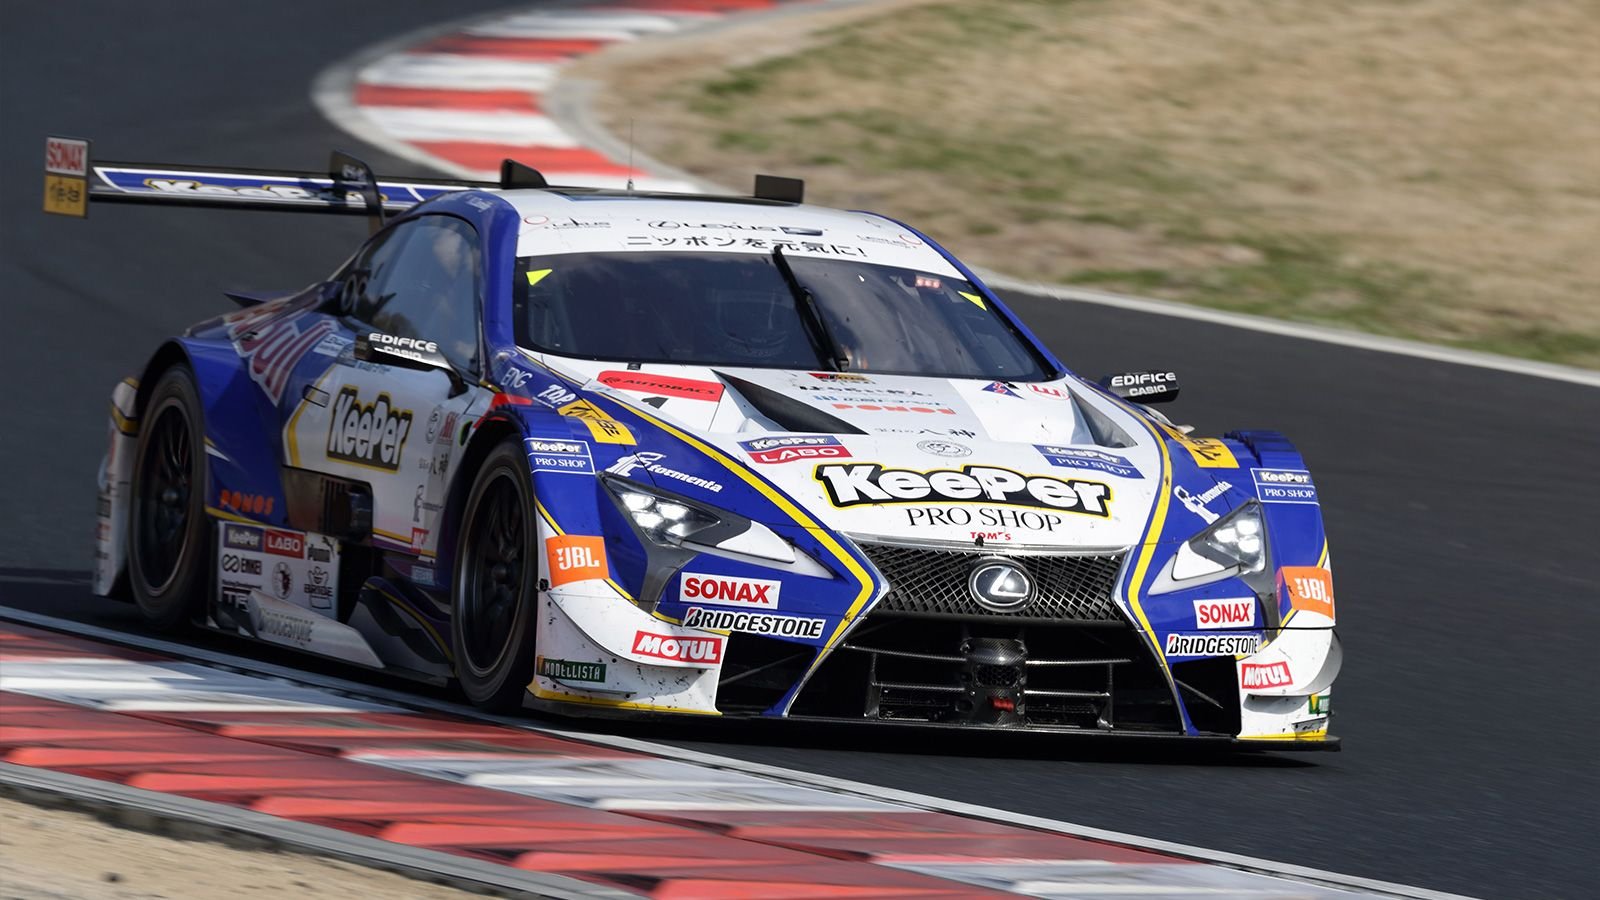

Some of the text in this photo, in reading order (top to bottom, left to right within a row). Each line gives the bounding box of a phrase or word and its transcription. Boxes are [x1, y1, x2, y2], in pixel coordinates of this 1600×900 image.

[368, 332, 438, 353] EDIFICE
[622, 377, 715, 395] AUTOBACS
[1111, 372, 1177, 387] EDIFICE
[1129, 385, 1167, 397] CASIO
[328, 386, 412, 473] KeePer
[530, 440, 582, 453] KeePer
[749, 436, 828, 451] KeePer
[535, 457, 586, 468] PRO SHOP
[760, 448, 840, 462] LABO
[1045, 446, 1122, 464] KeePer
[1057, 457, 1131, 475] PRO SHOP
[1259, 471, 1311, 484] KeePer
[816, 463, 1111, 517] KeePer
[1265, 488, 1315, 499] PRO SHOP
[907, 506, 1062, 532] PRO SHOP
[228, 527, 259, 547] KeePer
[267, 536, 301, 552] LABO
[684, 577, 770, 604] SONAX
[1199, 602, 1251, 624] SONAX
[684, 607, 823, 638] BRIDGESTONE
[636, 634, 718, 661] MOTUL
[1168, 636, 1259, 655] BRIDGESTONE
[544, 661, 600, 680] MODELLISTA
[1243, 664, 1291, 687] MOTUL
